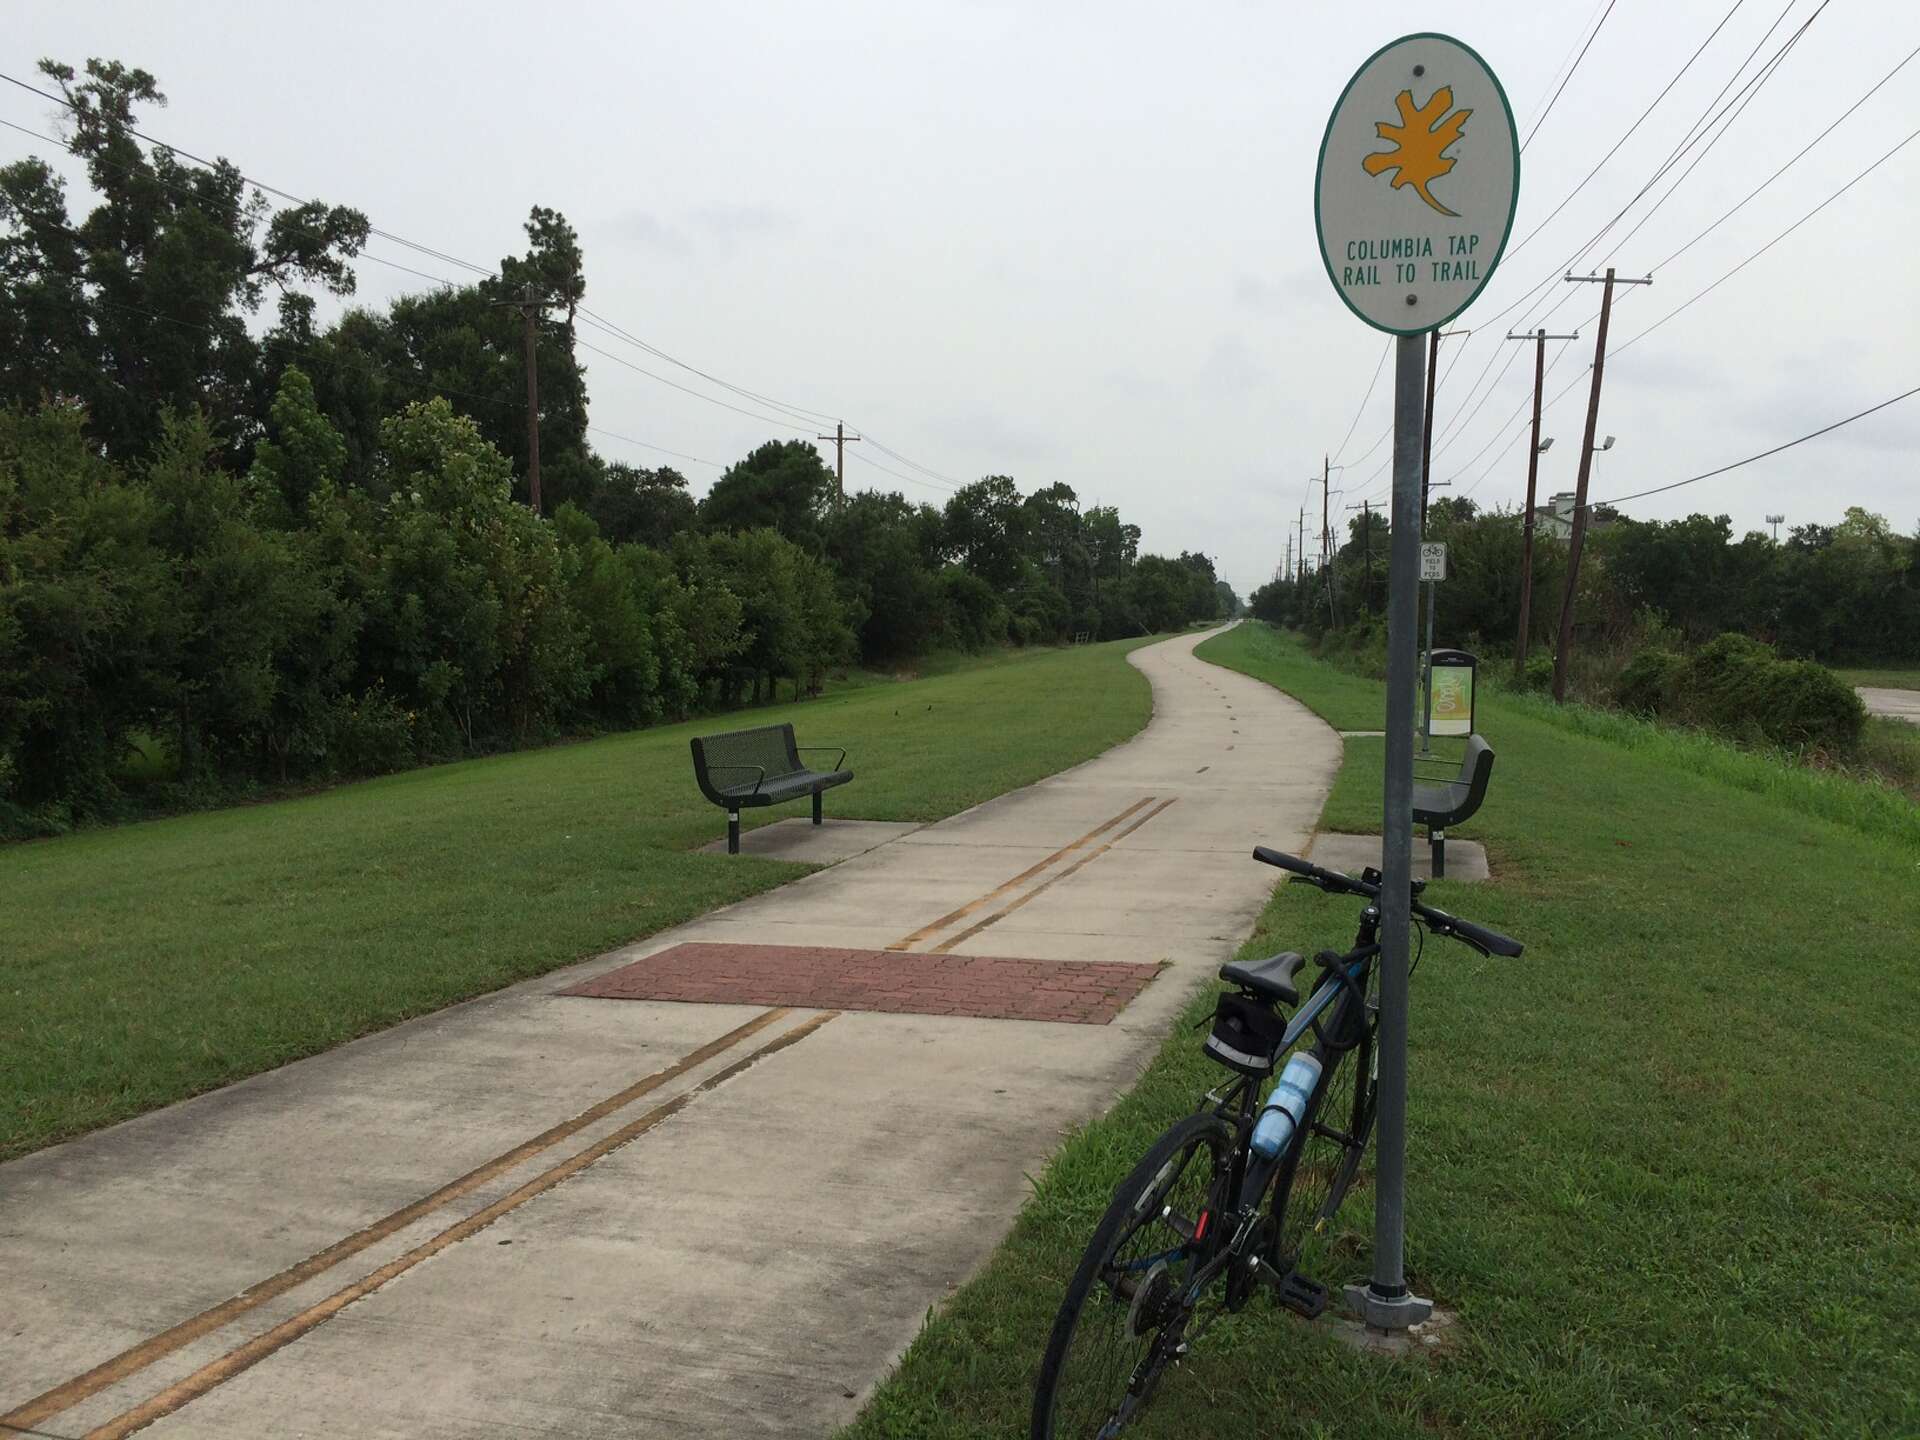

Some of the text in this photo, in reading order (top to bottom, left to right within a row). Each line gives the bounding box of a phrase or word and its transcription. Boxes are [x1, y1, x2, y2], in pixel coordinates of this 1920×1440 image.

[1347, 235, 1479, 260] COLUMBIA TAP
[1344, 260, 1480, 286] RAIL TO TRAIL
